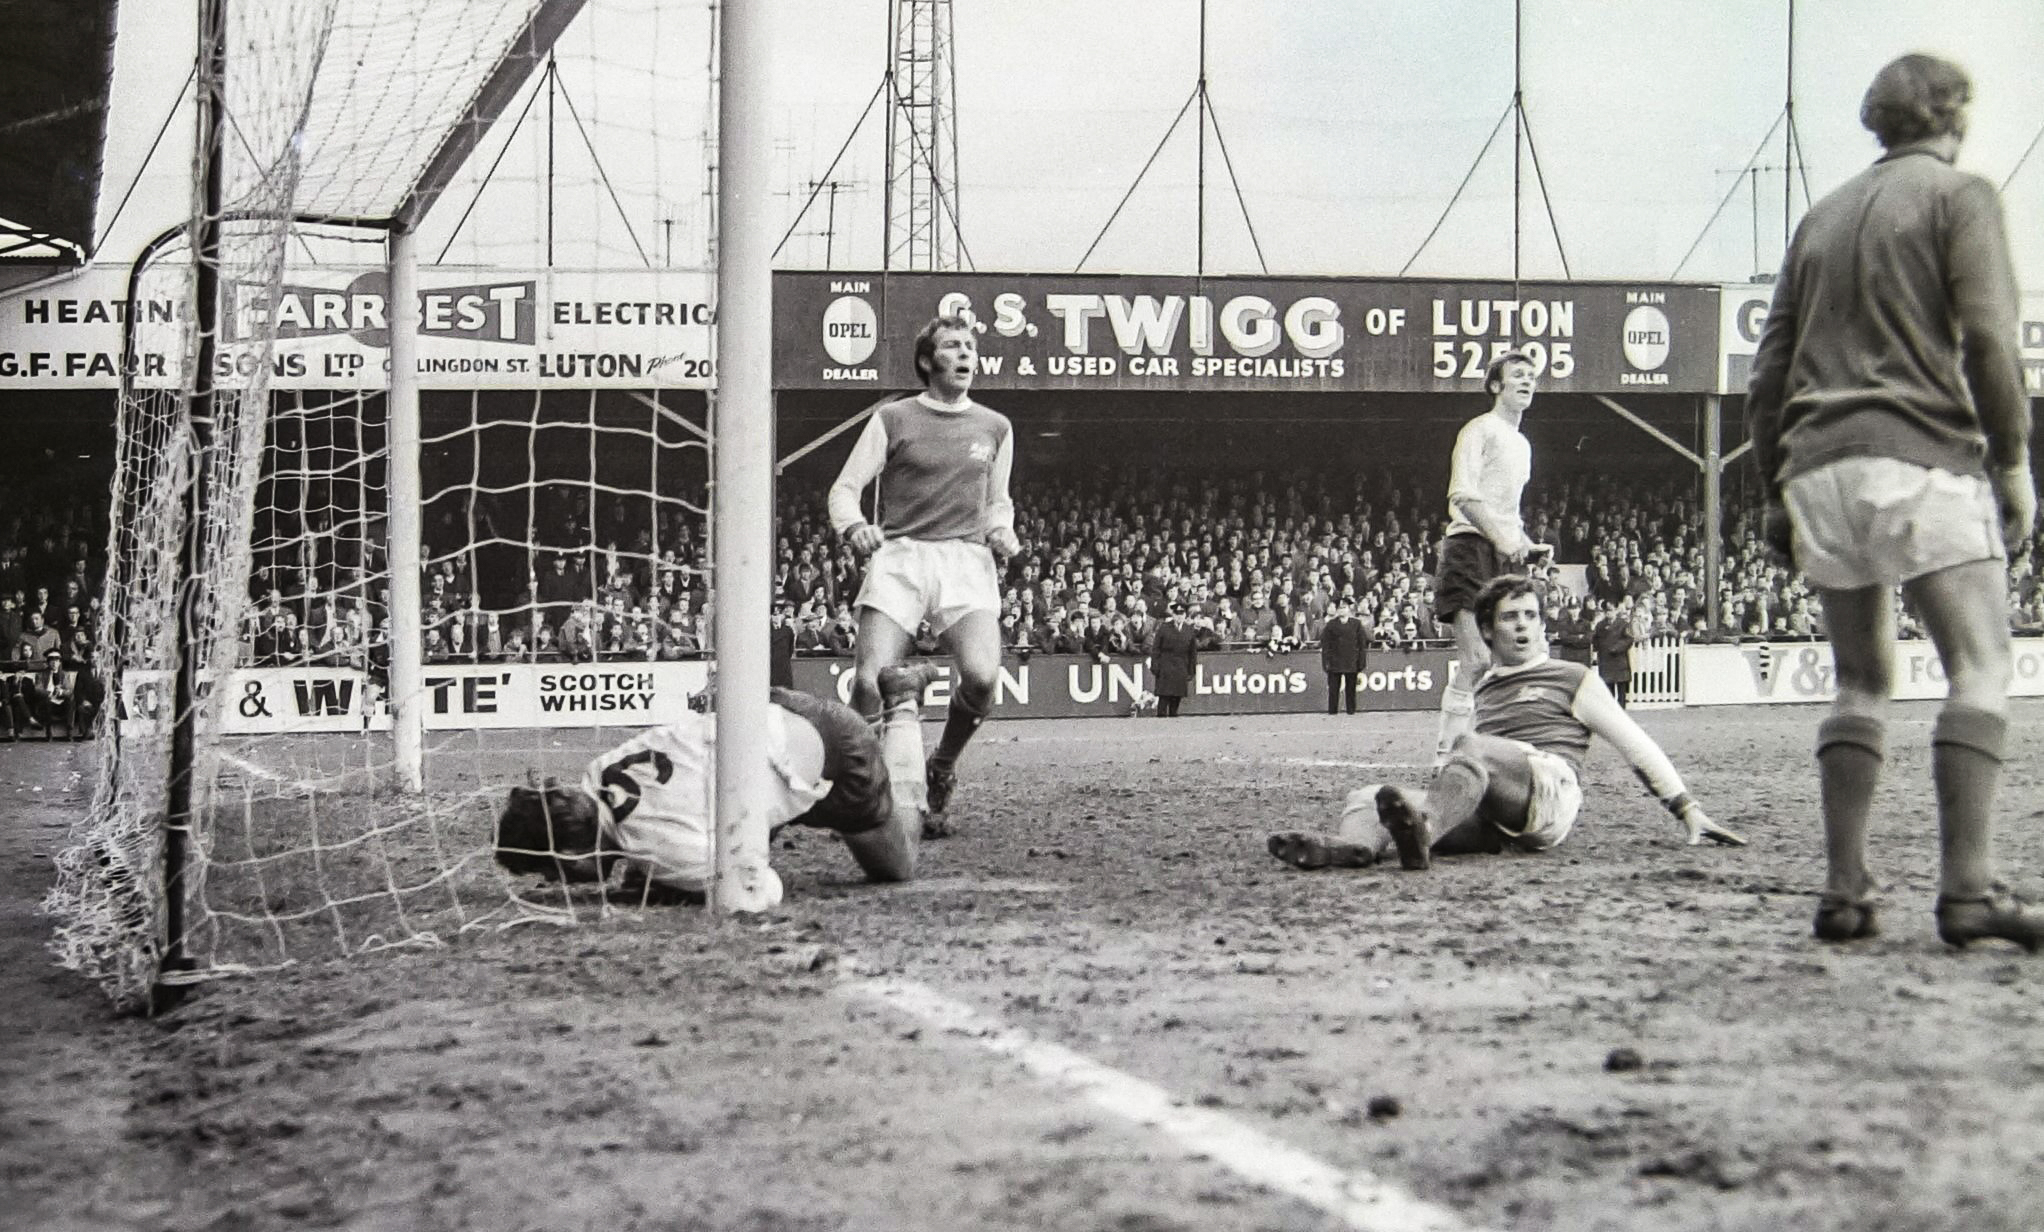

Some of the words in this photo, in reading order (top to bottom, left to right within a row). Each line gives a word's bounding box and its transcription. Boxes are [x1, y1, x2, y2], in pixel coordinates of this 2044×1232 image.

[830, 281, 870, 294] MAIN
[1626, 293, 1666, 304] MAIN
[828, 322, 872, 339] OPEL
[1046, 294, 1344, 358] TWIGG
[1365, 308, 1406, 335] OF
[1432, 299, 1574, 337] LUTON
[1628, 330, 1666, 346] OPEL
[539, 353, 641, 378] LUTON
[684, 359, 718, 378] 20
[822, 367, 878, 381] DEALER
[1017, 356, 1037, 376] &
[1047, 356, 1116, 375] USED
[1129, 357, 1179, 377] CAR
[1191, 358, 1345, 378] SPECIALISTS
[1620, 373, 1669, 386] DEALER
[540, 673, 654, 692] SCOTCH
[1195, 664, 1307, 695] Luton's
[540, 693, 655, 713] WHISKY
